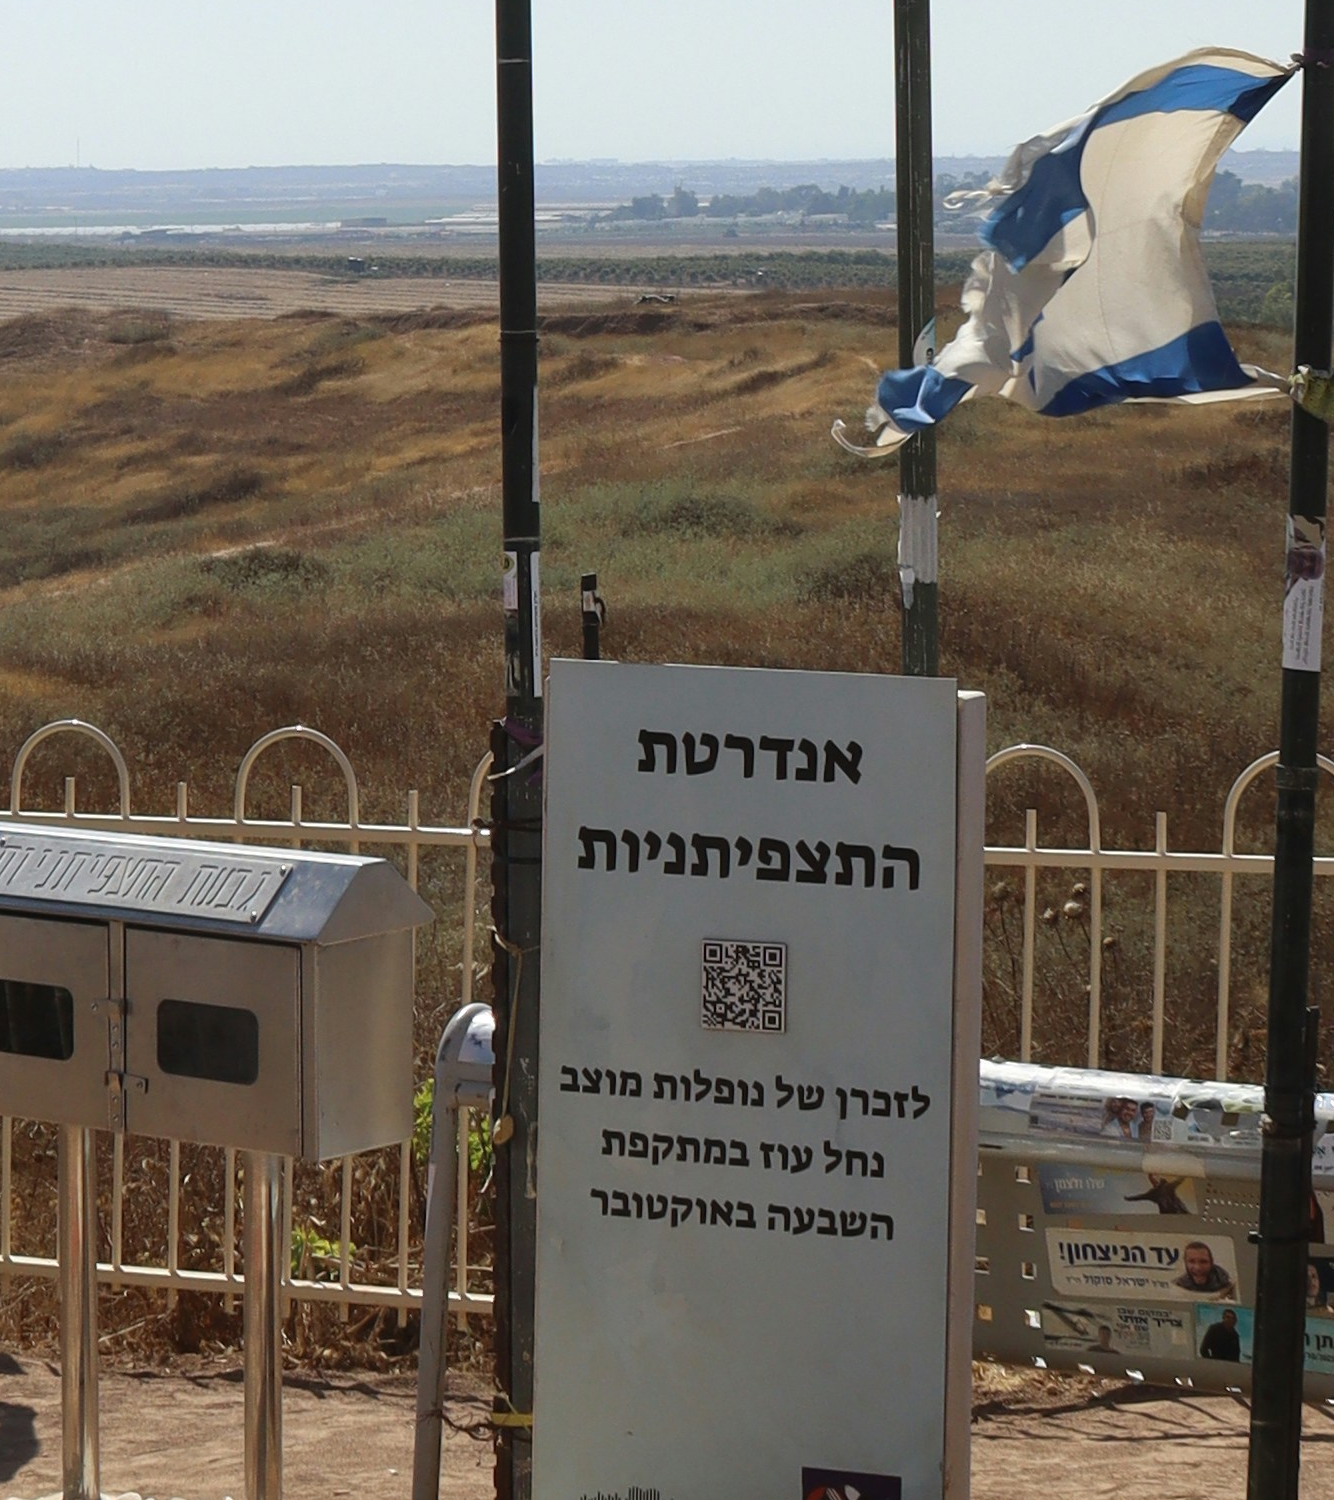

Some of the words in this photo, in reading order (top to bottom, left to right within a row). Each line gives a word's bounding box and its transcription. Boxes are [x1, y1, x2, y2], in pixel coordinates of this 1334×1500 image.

[638, 730, 862, 784] אנדרטת
[578, 826, 919, 890] התצפיתניות
[560, 1066, 641, 1097] מוצב
[654, 1069, 764, 1107] נופלות
[776, 1075, 824, 1110] של
[836, 1086, 930, 1120] לזכרן
[602, 1129, 749, 1167] במתקפת
[760, 1142, 813, 1173] עוז
[824, 1141, 884, 1178] נחל
[591, 1189, 756, 1228] באוקטובר
[768, 1204, 893, 1240] השבעה
[1058, 1241, 1146, 1265] הניצחון!
[1149, 1246, 1181, 1266] עד
[1082, 1273, 1113, 1287] סוקול
[1114, 1275, 1150, 1287] ישראל
